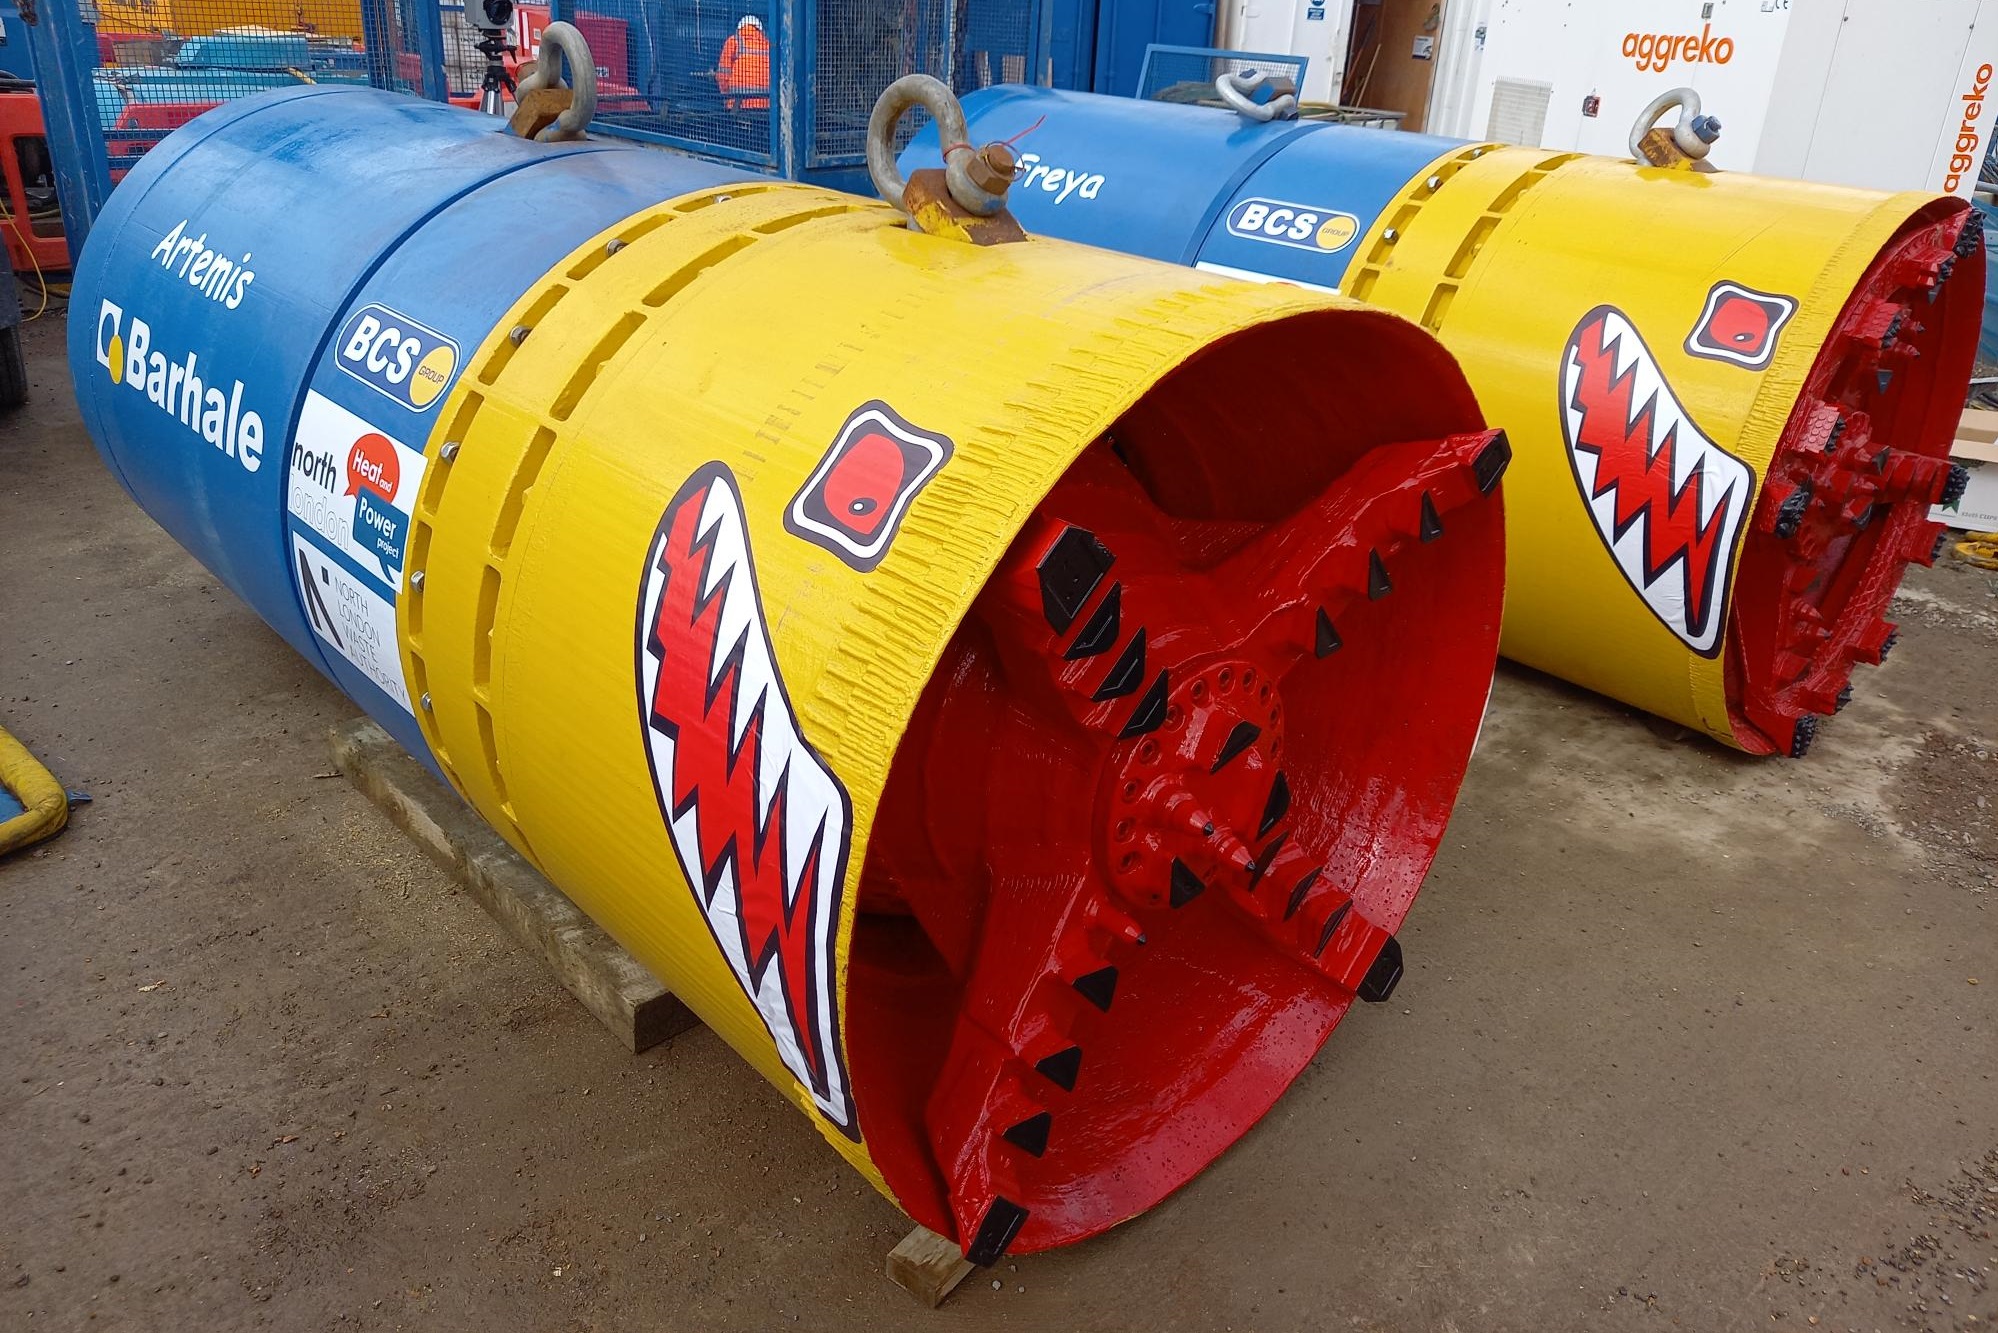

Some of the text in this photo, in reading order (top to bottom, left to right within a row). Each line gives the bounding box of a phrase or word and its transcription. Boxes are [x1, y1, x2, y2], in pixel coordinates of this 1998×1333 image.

[1622, 23, 1735, 73] aggreko
[1943, 63, 1993, 193] aggreko
[1013, 152, 1106, 205] Freya
[1236, 203, 1318, 240] BCS
[151, 219, 255, 310] Artemis
[342, 314, 421, 384] BCS
[126, 316, 264, 473] Barhale
[418, 365, 445, 385] GROUP
[292, 441, 337, 494] north
[352, 448, 393, 493] Heat and
[288, 473, 349, 551] london
[359, 496, 397, 540] Power
[376, 537, 400, 559] project
[334, 576, 370, 617] NORTH
[337, 598, 381, 647] LONDON
